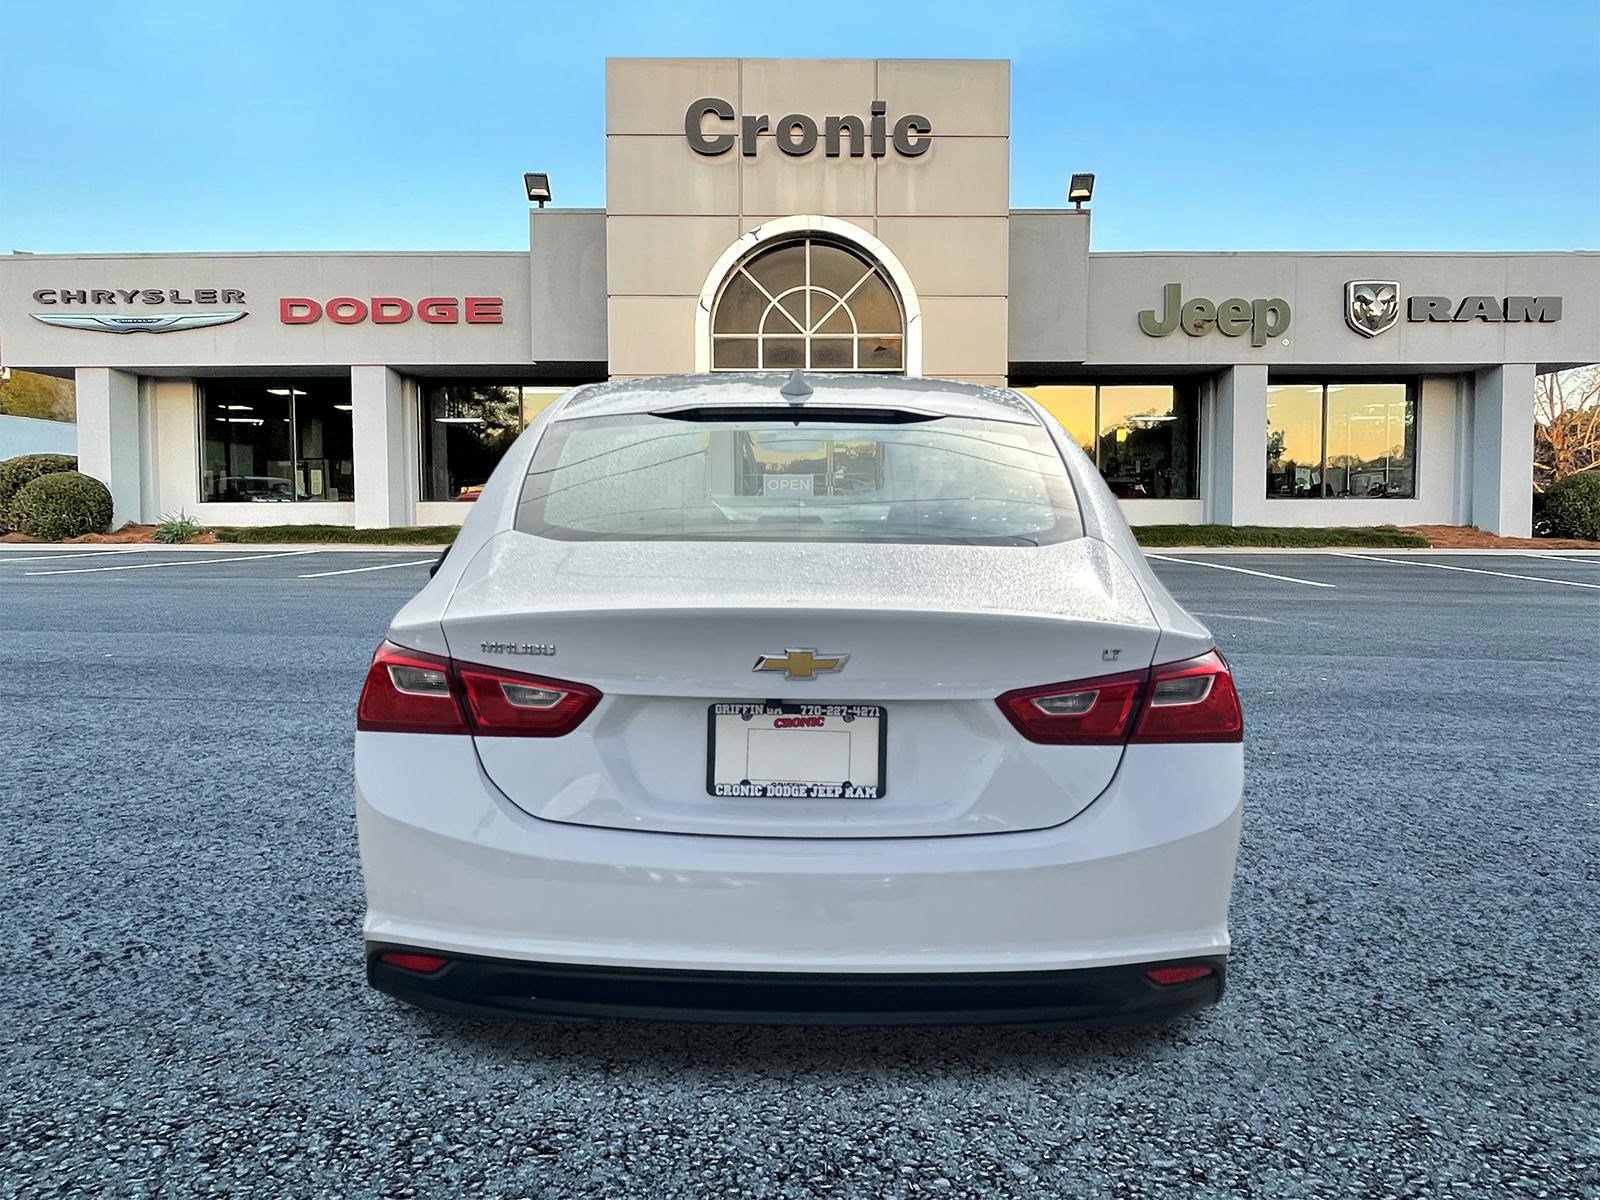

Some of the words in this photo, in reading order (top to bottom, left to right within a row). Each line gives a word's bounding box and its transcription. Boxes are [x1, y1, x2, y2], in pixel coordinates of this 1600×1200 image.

[685, 97, 932, 157] Cronic
[32, 288, 246, 305] CHRYSLER
[280, 297, 503, 324] DODGE
[1138, 283, 1291, 347] Jeep
[1407, 296, 1563, 323] RAM
[767, 479, 810, 490] OPEN
[480, 641, 556, 656] MALIBU
[1102, 649, 1121, 661] LT
[715, 704, 764, 715] GRIFFIN
[800, 705, 880, 717] 770-227-4271
[773, 717, 825, 728] CRONIC
[715, 784, 763, 797] CRONIC
[766, 785, 808, 798] DODGE
[810, 785, 843, 798] JEEP
[844, 786, 878, 798] RAM
